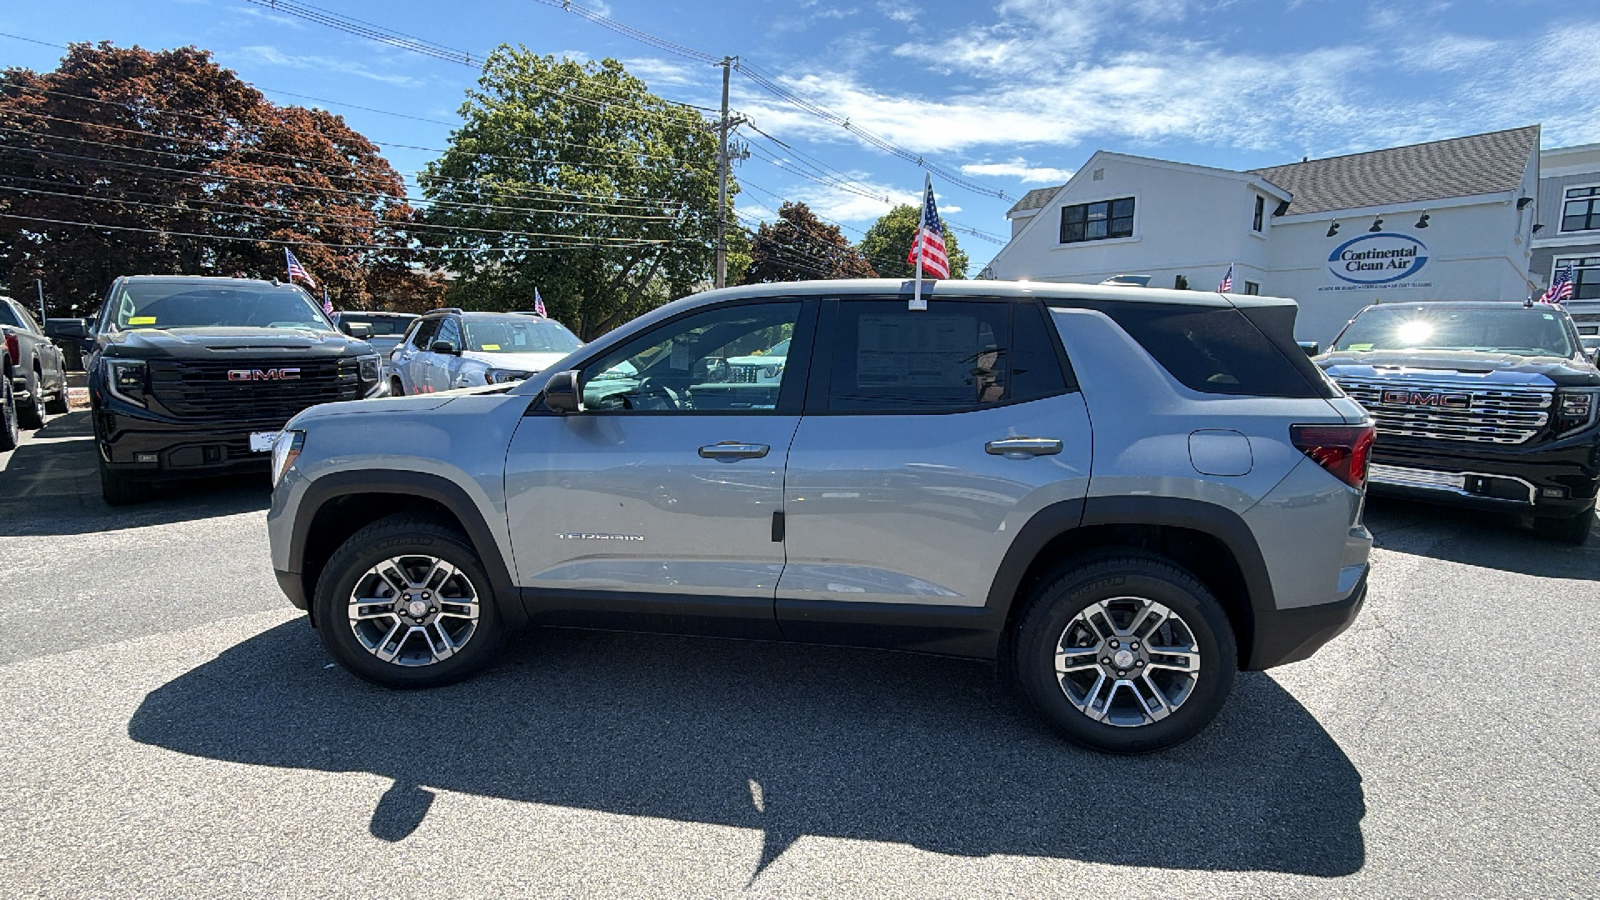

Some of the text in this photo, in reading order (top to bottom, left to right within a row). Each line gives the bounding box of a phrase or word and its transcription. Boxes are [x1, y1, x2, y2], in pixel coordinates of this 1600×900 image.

[1341, 245, 1418, 261] Continental
[1345, 258, 1411, 272] Clean Air
[227, 367, 301, 381] GMC
[1384, 391, 1467, 408] GMC
[555, 532, 644, 541] TERRAIN
